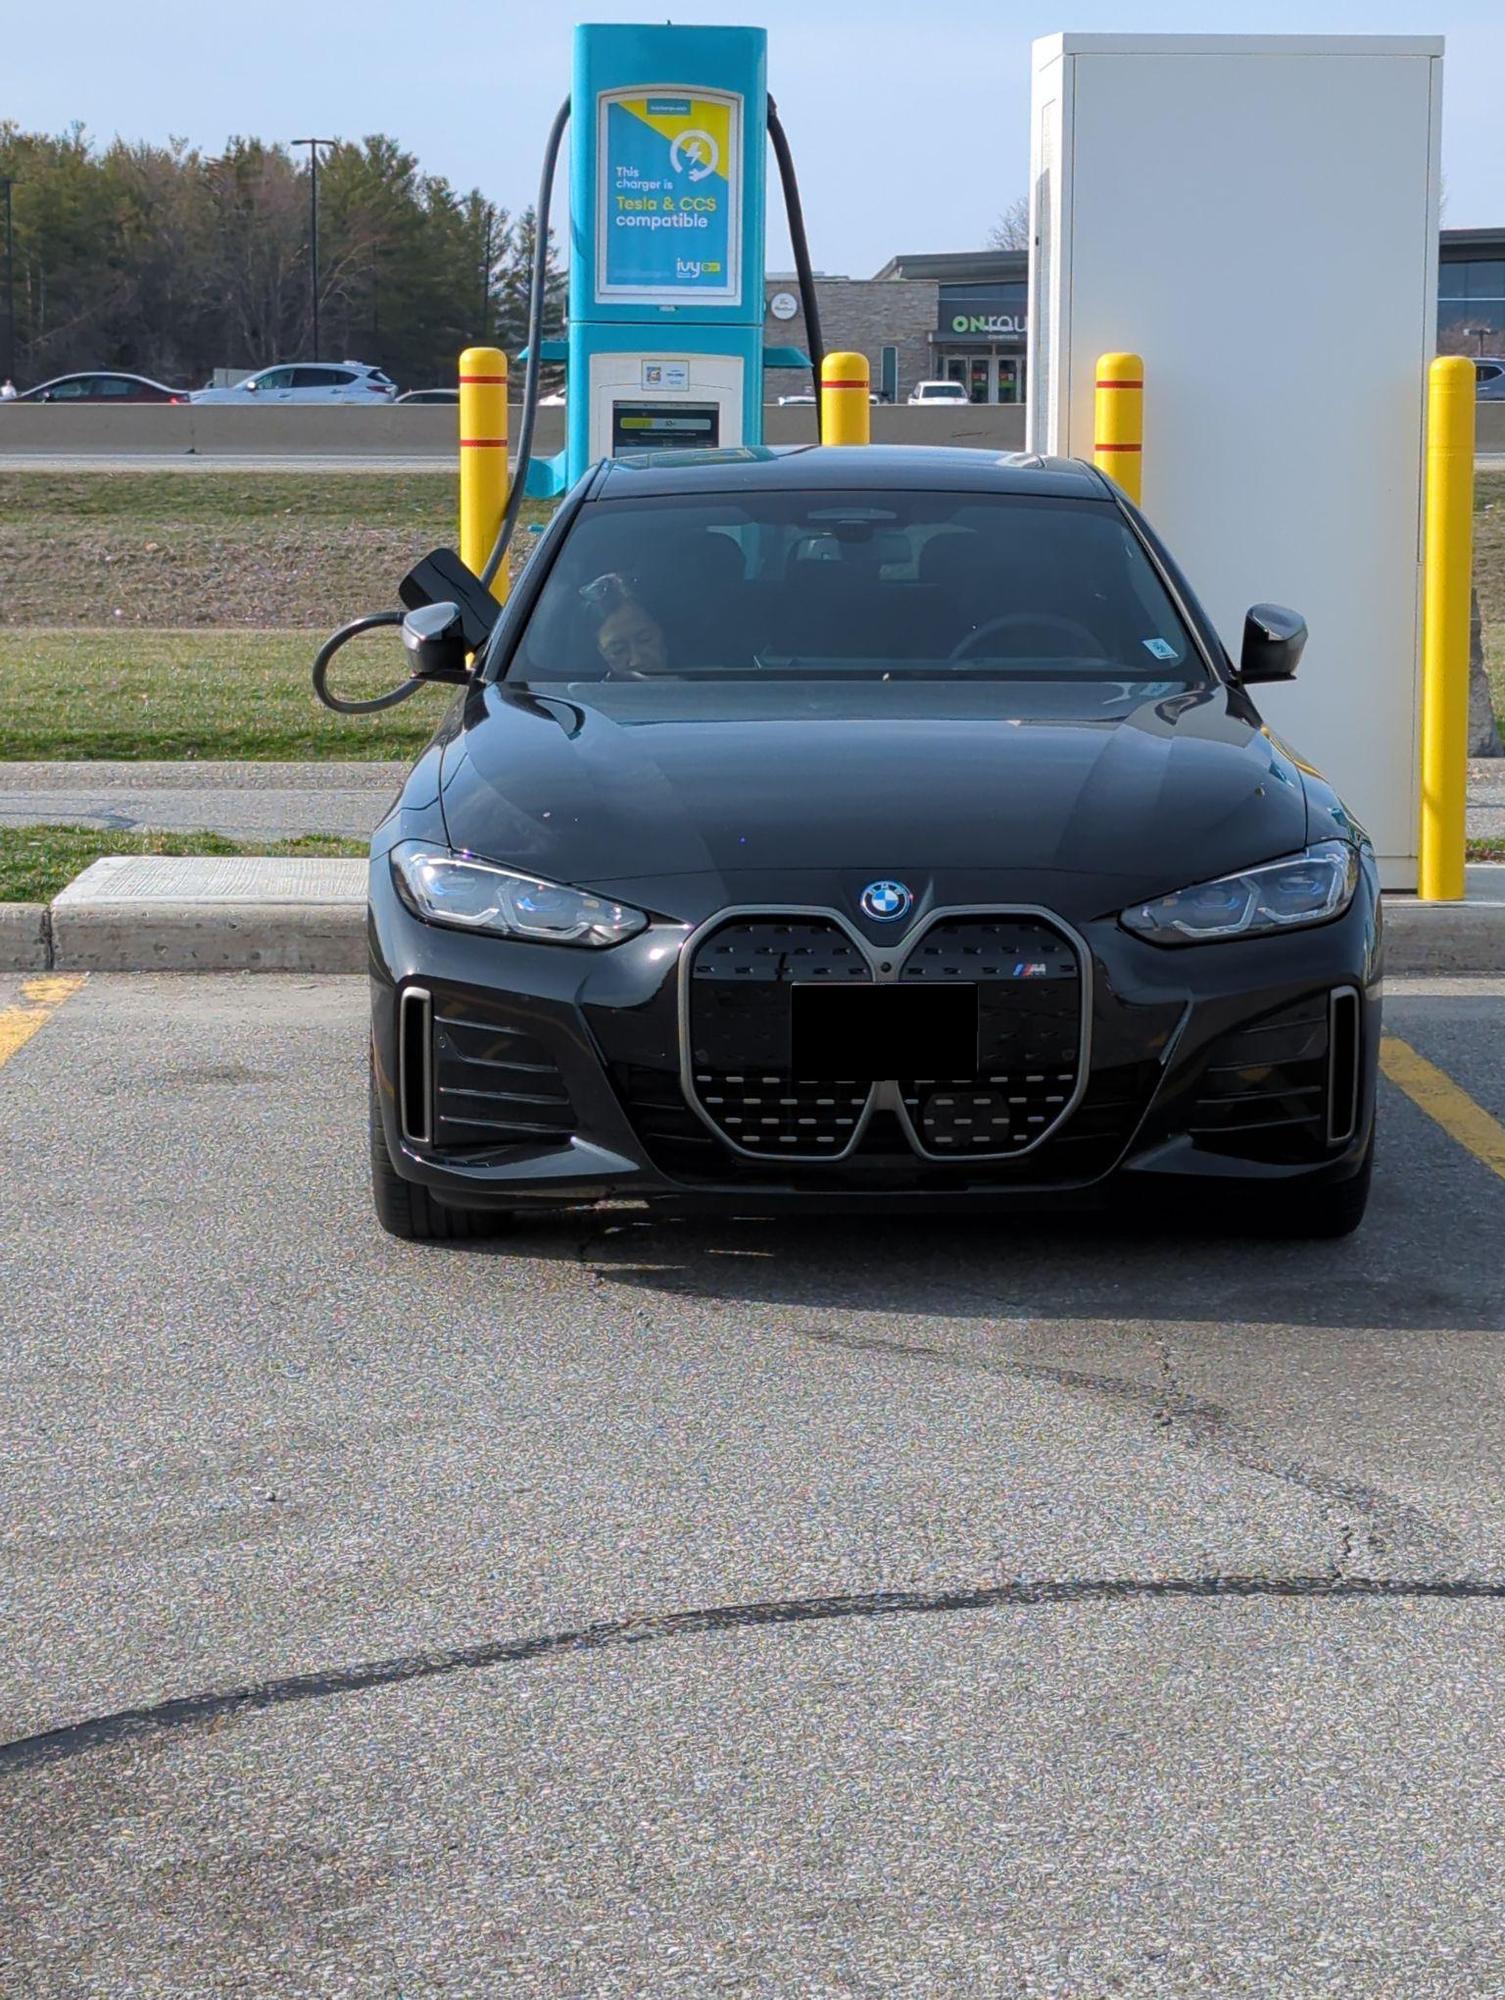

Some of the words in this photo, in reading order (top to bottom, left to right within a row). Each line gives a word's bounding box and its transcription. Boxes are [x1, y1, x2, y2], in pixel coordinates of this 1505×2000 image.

[616, 166, 639, 177] This
[616, 178, 661, 191] charger
[663, 178, 673, 189] is
[616, 196, 657, 210] Tesla
[663, 196, 674, 210] &
[680, 197, 717, 211] CCS
[616, 212, 708, 230] compatible
[676, 257, 700, 278] ivy
